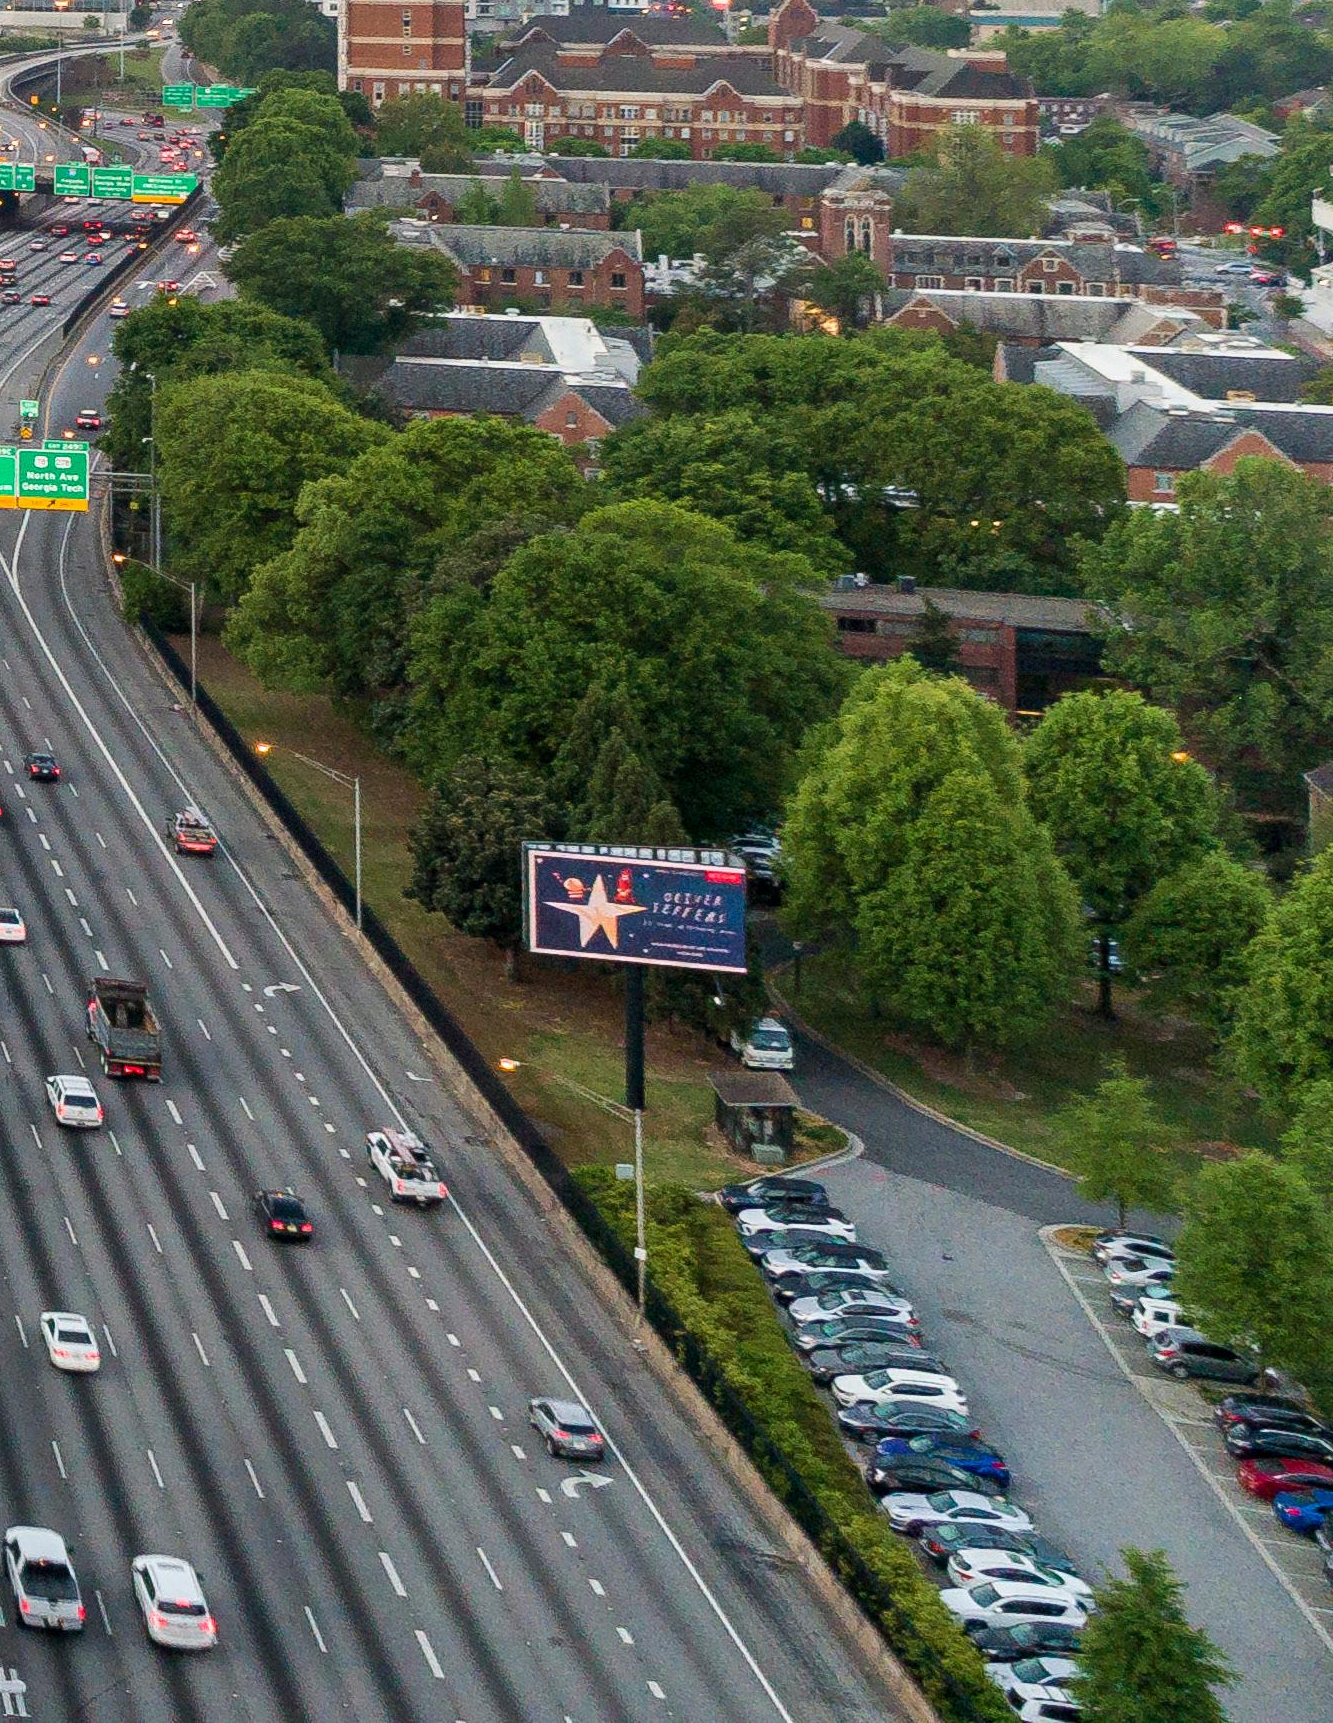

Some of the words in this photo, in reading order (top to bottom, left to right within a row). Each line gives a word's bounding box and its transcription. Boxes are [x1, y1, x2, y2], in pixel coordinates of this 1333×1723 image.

[26, 471, 56, 480] North
[59, 472, 79, 482] Ave
[21, 482, 58, 493] Georgia
[60, 483, 85, 493] Tech
